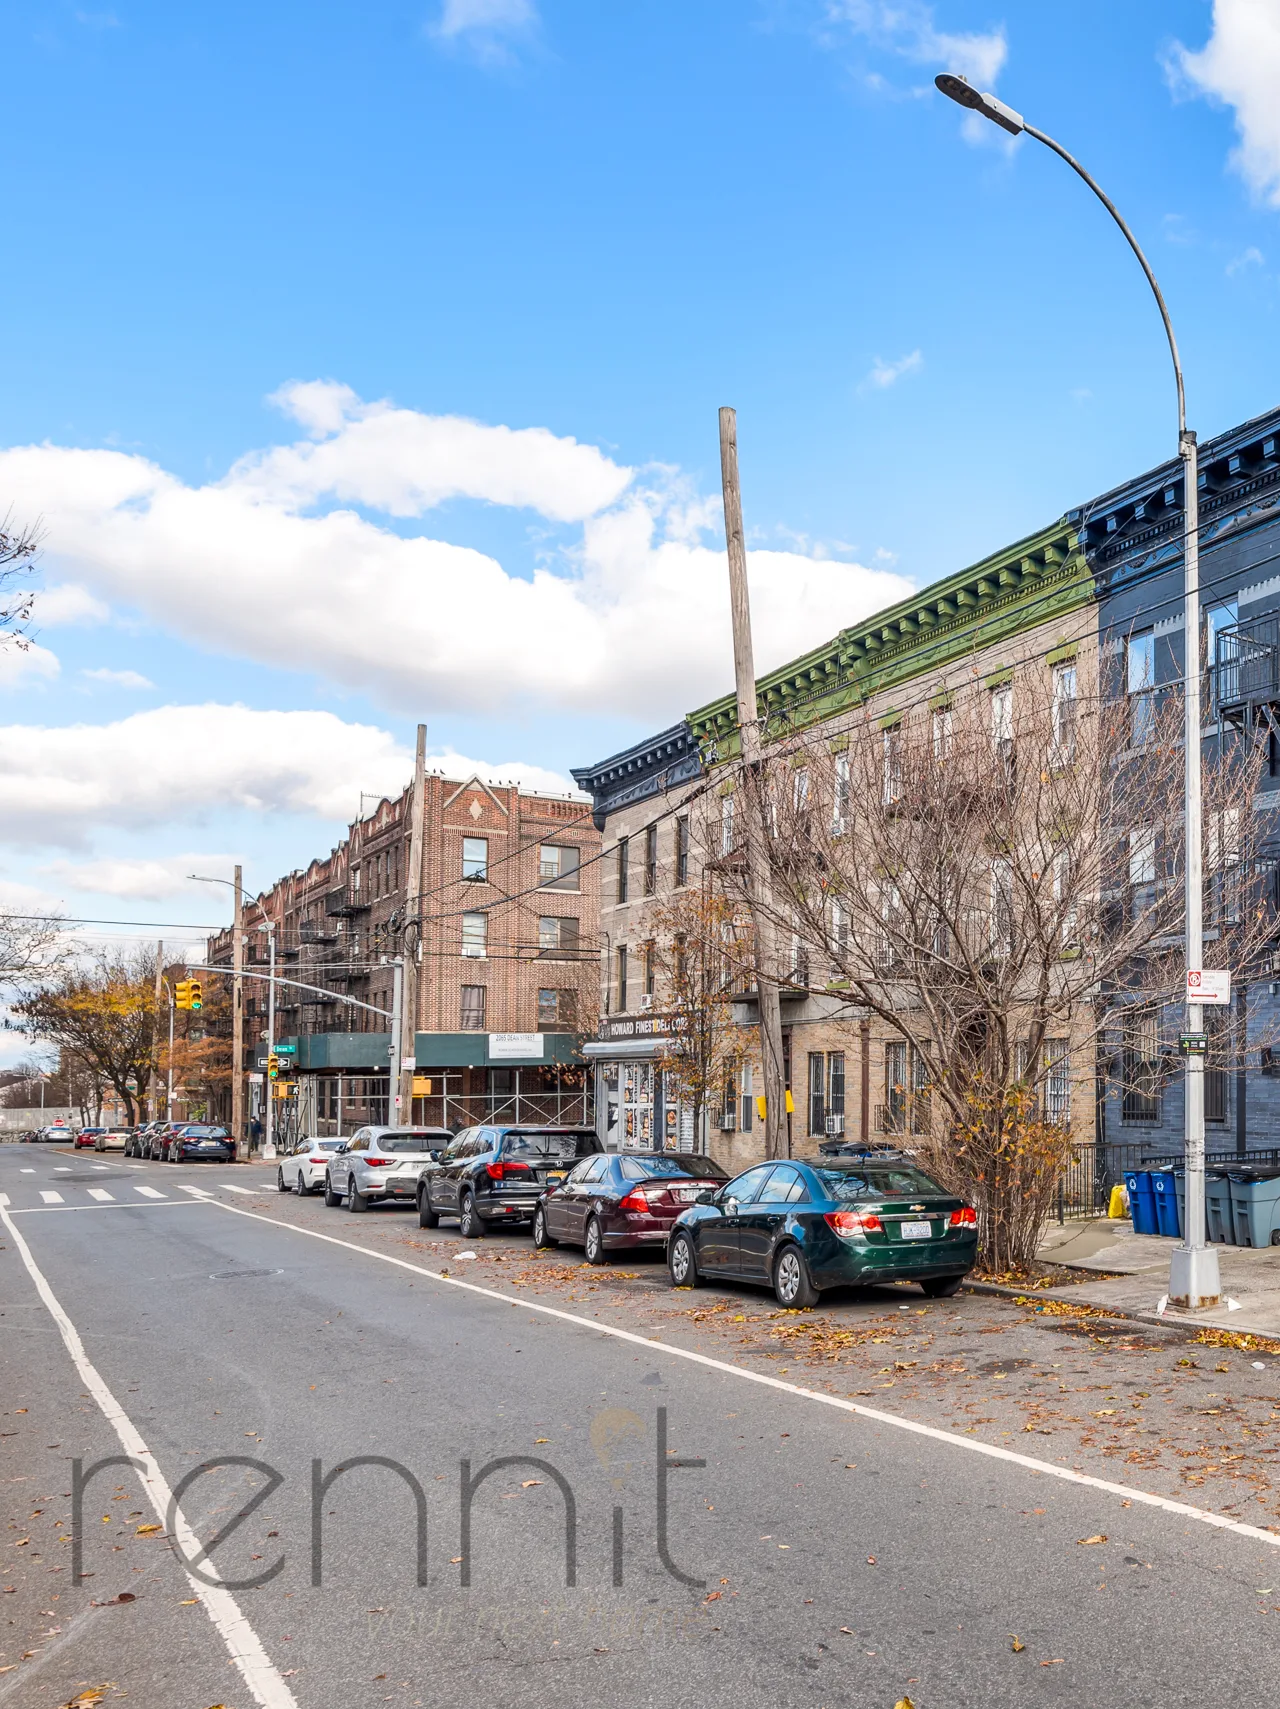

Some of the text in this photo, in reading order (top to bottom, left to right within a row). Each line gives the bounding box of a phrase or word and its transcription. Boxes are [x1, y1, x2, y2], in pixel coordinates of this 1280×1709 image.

[611, 1022, 634, 1036] HOWARD
[635, 1019, 655, 1034] FINEST
[656, 1018, 671, 1032] DELI
